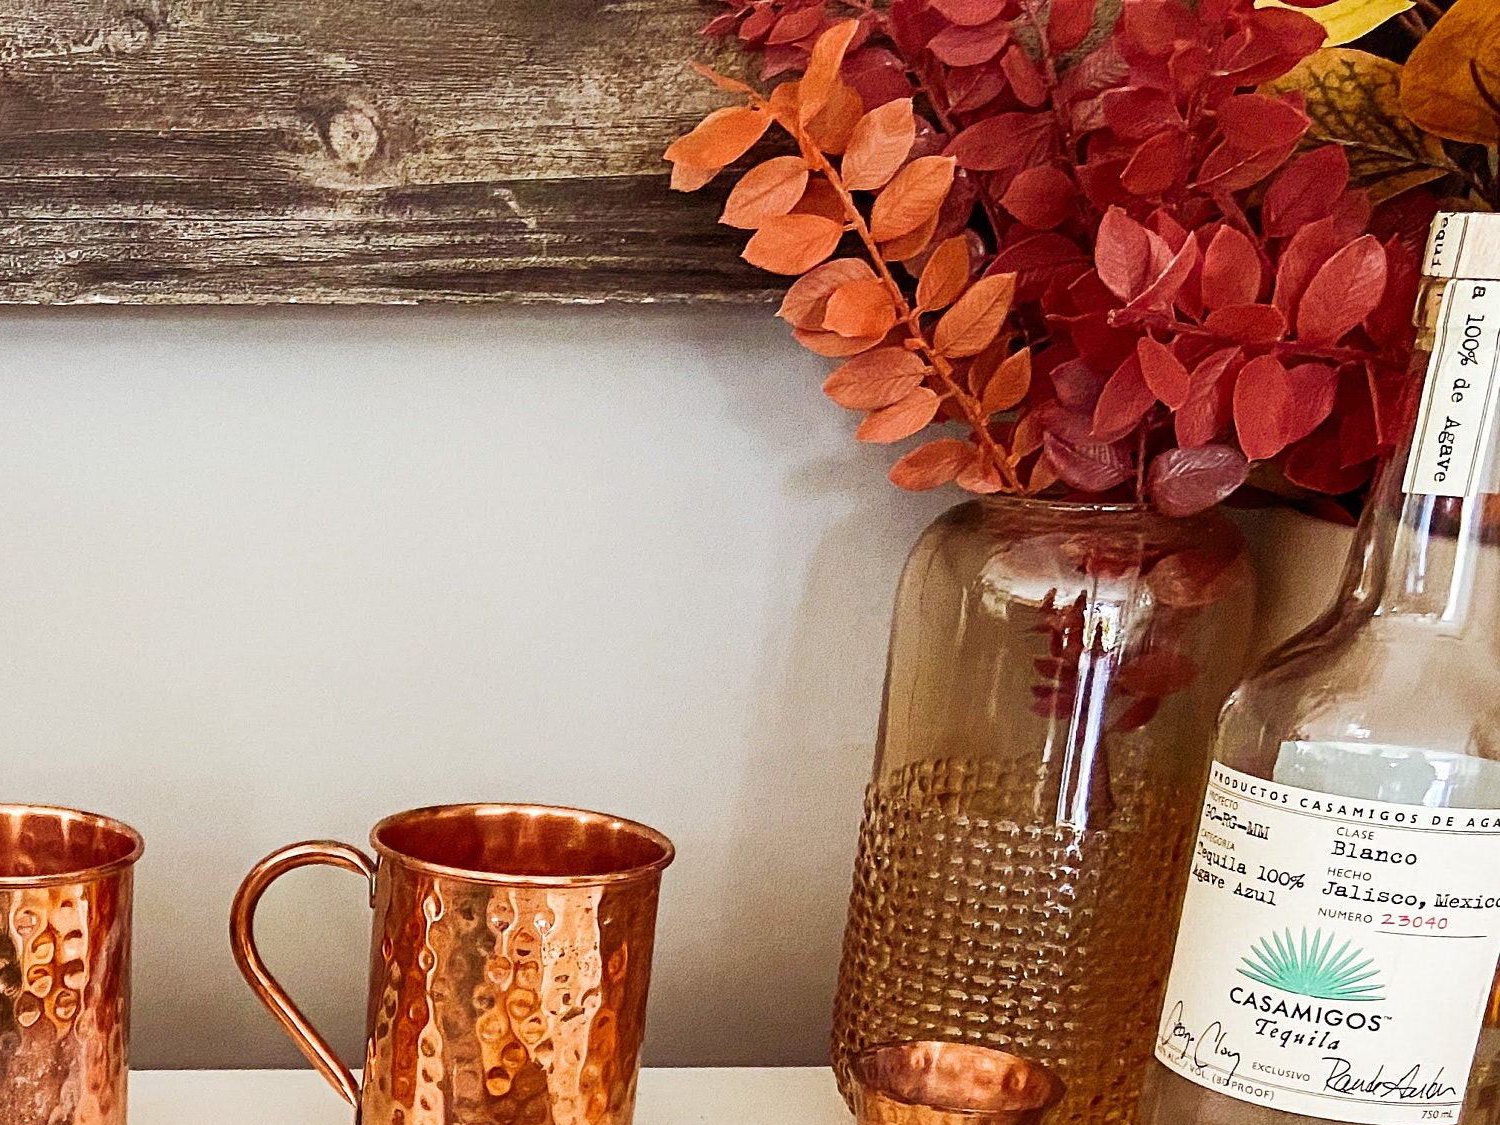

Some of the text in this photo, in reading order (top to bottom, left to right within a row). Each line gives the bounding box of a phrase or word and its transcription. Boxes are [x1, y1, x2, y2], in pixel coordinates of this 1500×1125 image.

[1457, 315, 1485, 366] 100%
[1451, 378, 1470, 403] de
[1434, 416, 1462, 482] Agave
[1213, 770, 1288, 803] PRODUCTOS
[1300, 798, 1418, 824] CASAMIGOS
[1431, 816, 1454, 827] DE
[1336, 827, 1375, 840] CLASE
[1331, 840, 1417, 865] Blanco
[1197, 841, 1305, 890] Tequila 100%
[1327, 867, 1372, 881] HECHO
[1192, 863, 1276, 906] Agave Azul
[1322, 881, 1426, 910] Jalisco,
[1318, 908, 1448, 930] NUMERO 23040
[1255, 1018, 1341, 1050] Tequila
[1252, 1061, 1311, 1082] EXCLUSIVO
[1231, 1080, 1275, 1101] PROOF)
[1421, 1110, 1439, 1119] 750
